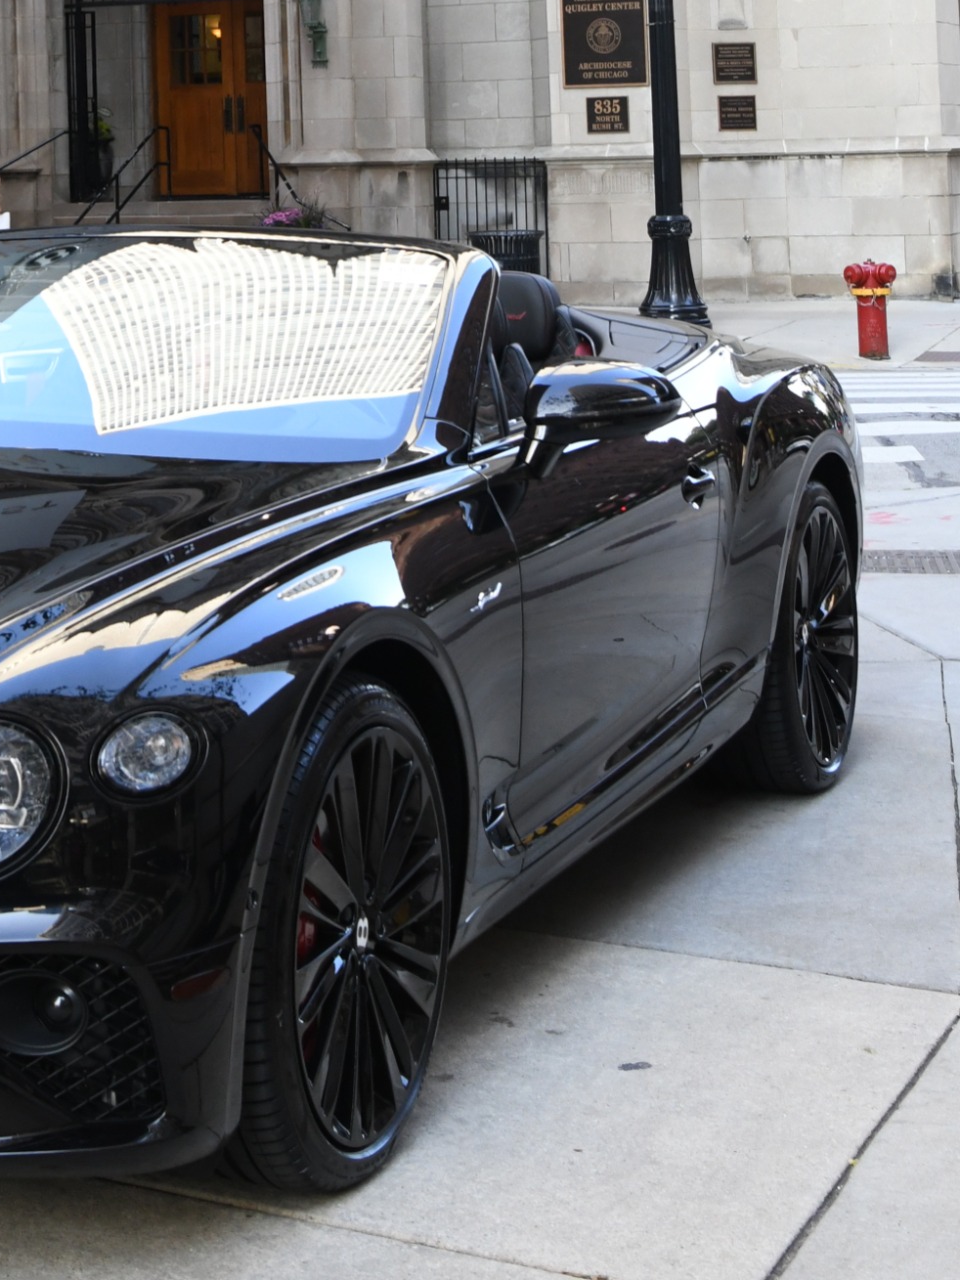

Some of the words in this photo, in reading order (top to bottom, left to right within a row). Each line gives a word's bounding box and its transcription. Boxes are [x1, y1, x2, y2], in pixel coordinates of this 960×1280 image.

[565, 3, 603, 14] QUIGLEY
[604, 1, 641, 12] CENTER
[578, 61, 632, 70] ARCHDIOCESE
[582, 71, 592, 79] OF
[594, 70, 628, 79] CHICAGO
[594, 99, 621, 114] 835
